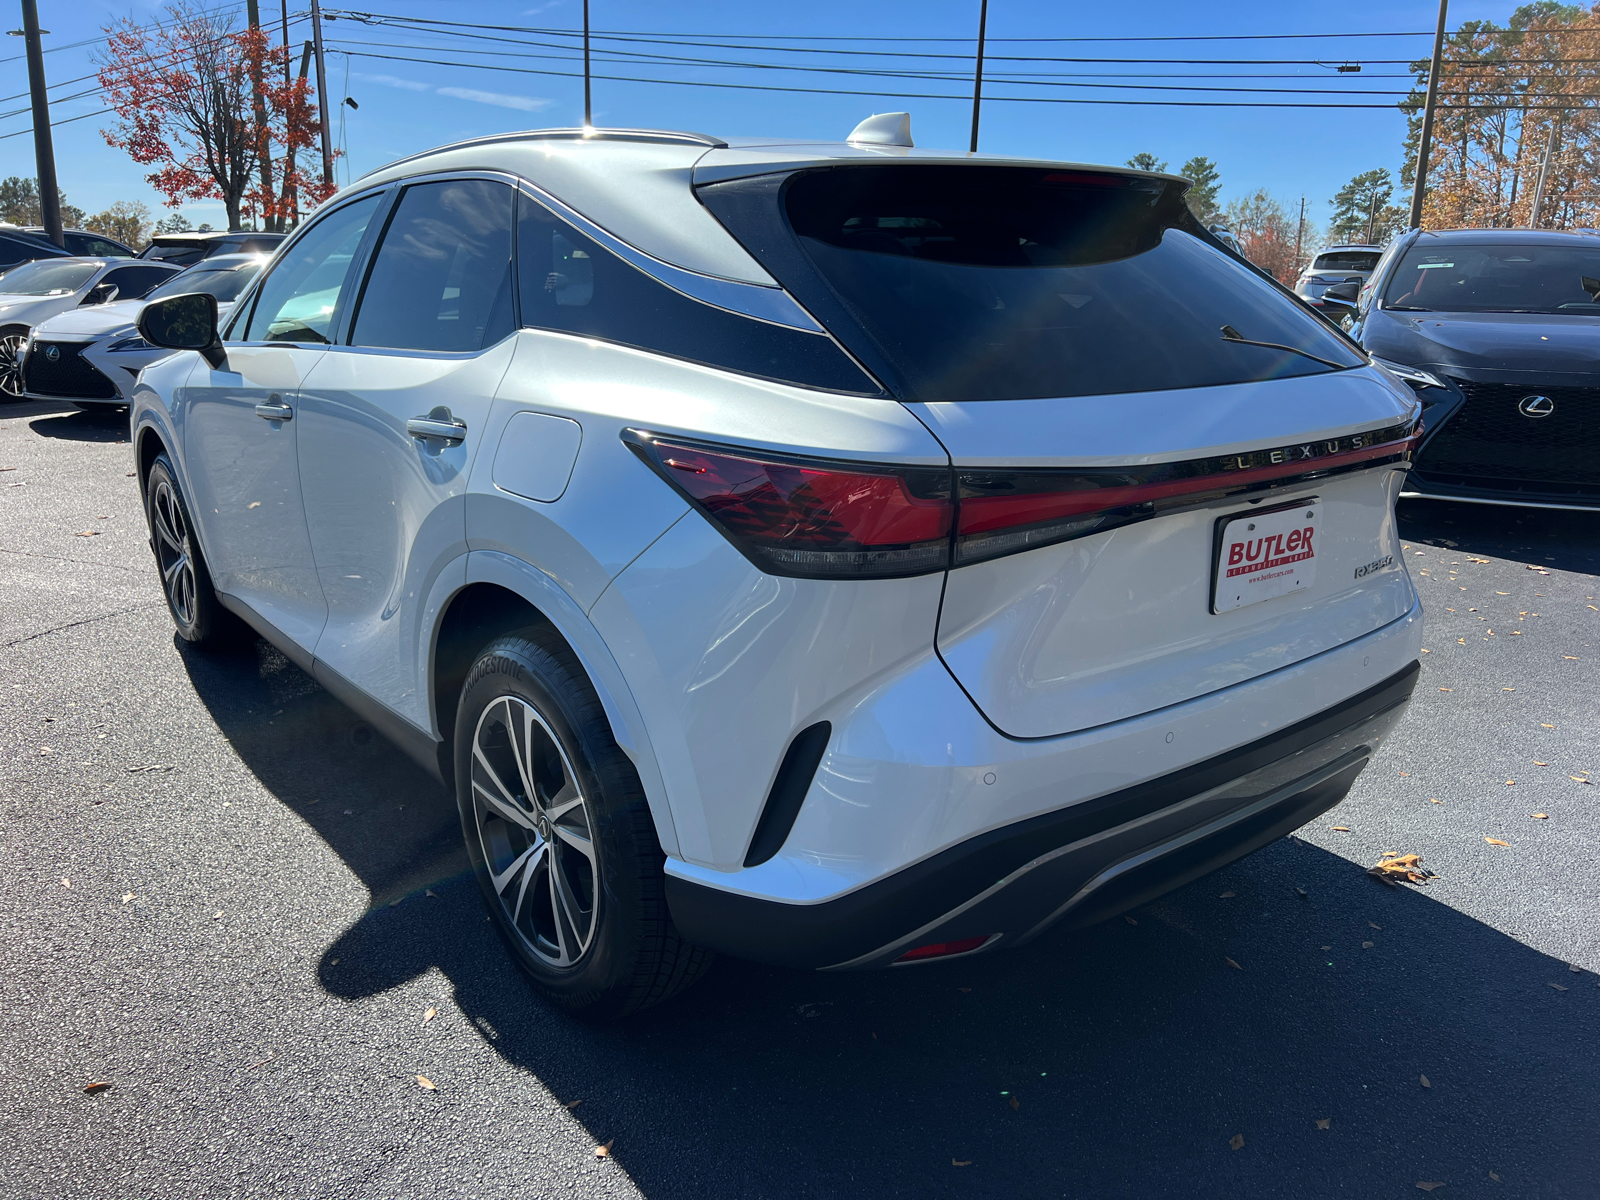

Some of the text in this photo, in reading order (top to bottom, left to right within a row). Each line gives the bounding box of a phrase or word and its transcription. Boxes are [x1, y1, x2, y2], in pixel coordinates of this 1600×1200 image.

[1236, 436, 1363, 470] LEXUS
[1289, 550, 1313, 563] GROUP
[1248, 568, 1294, 584] www.butlercars.com
[463, 656, 526, 703] BRIDGESTONE
